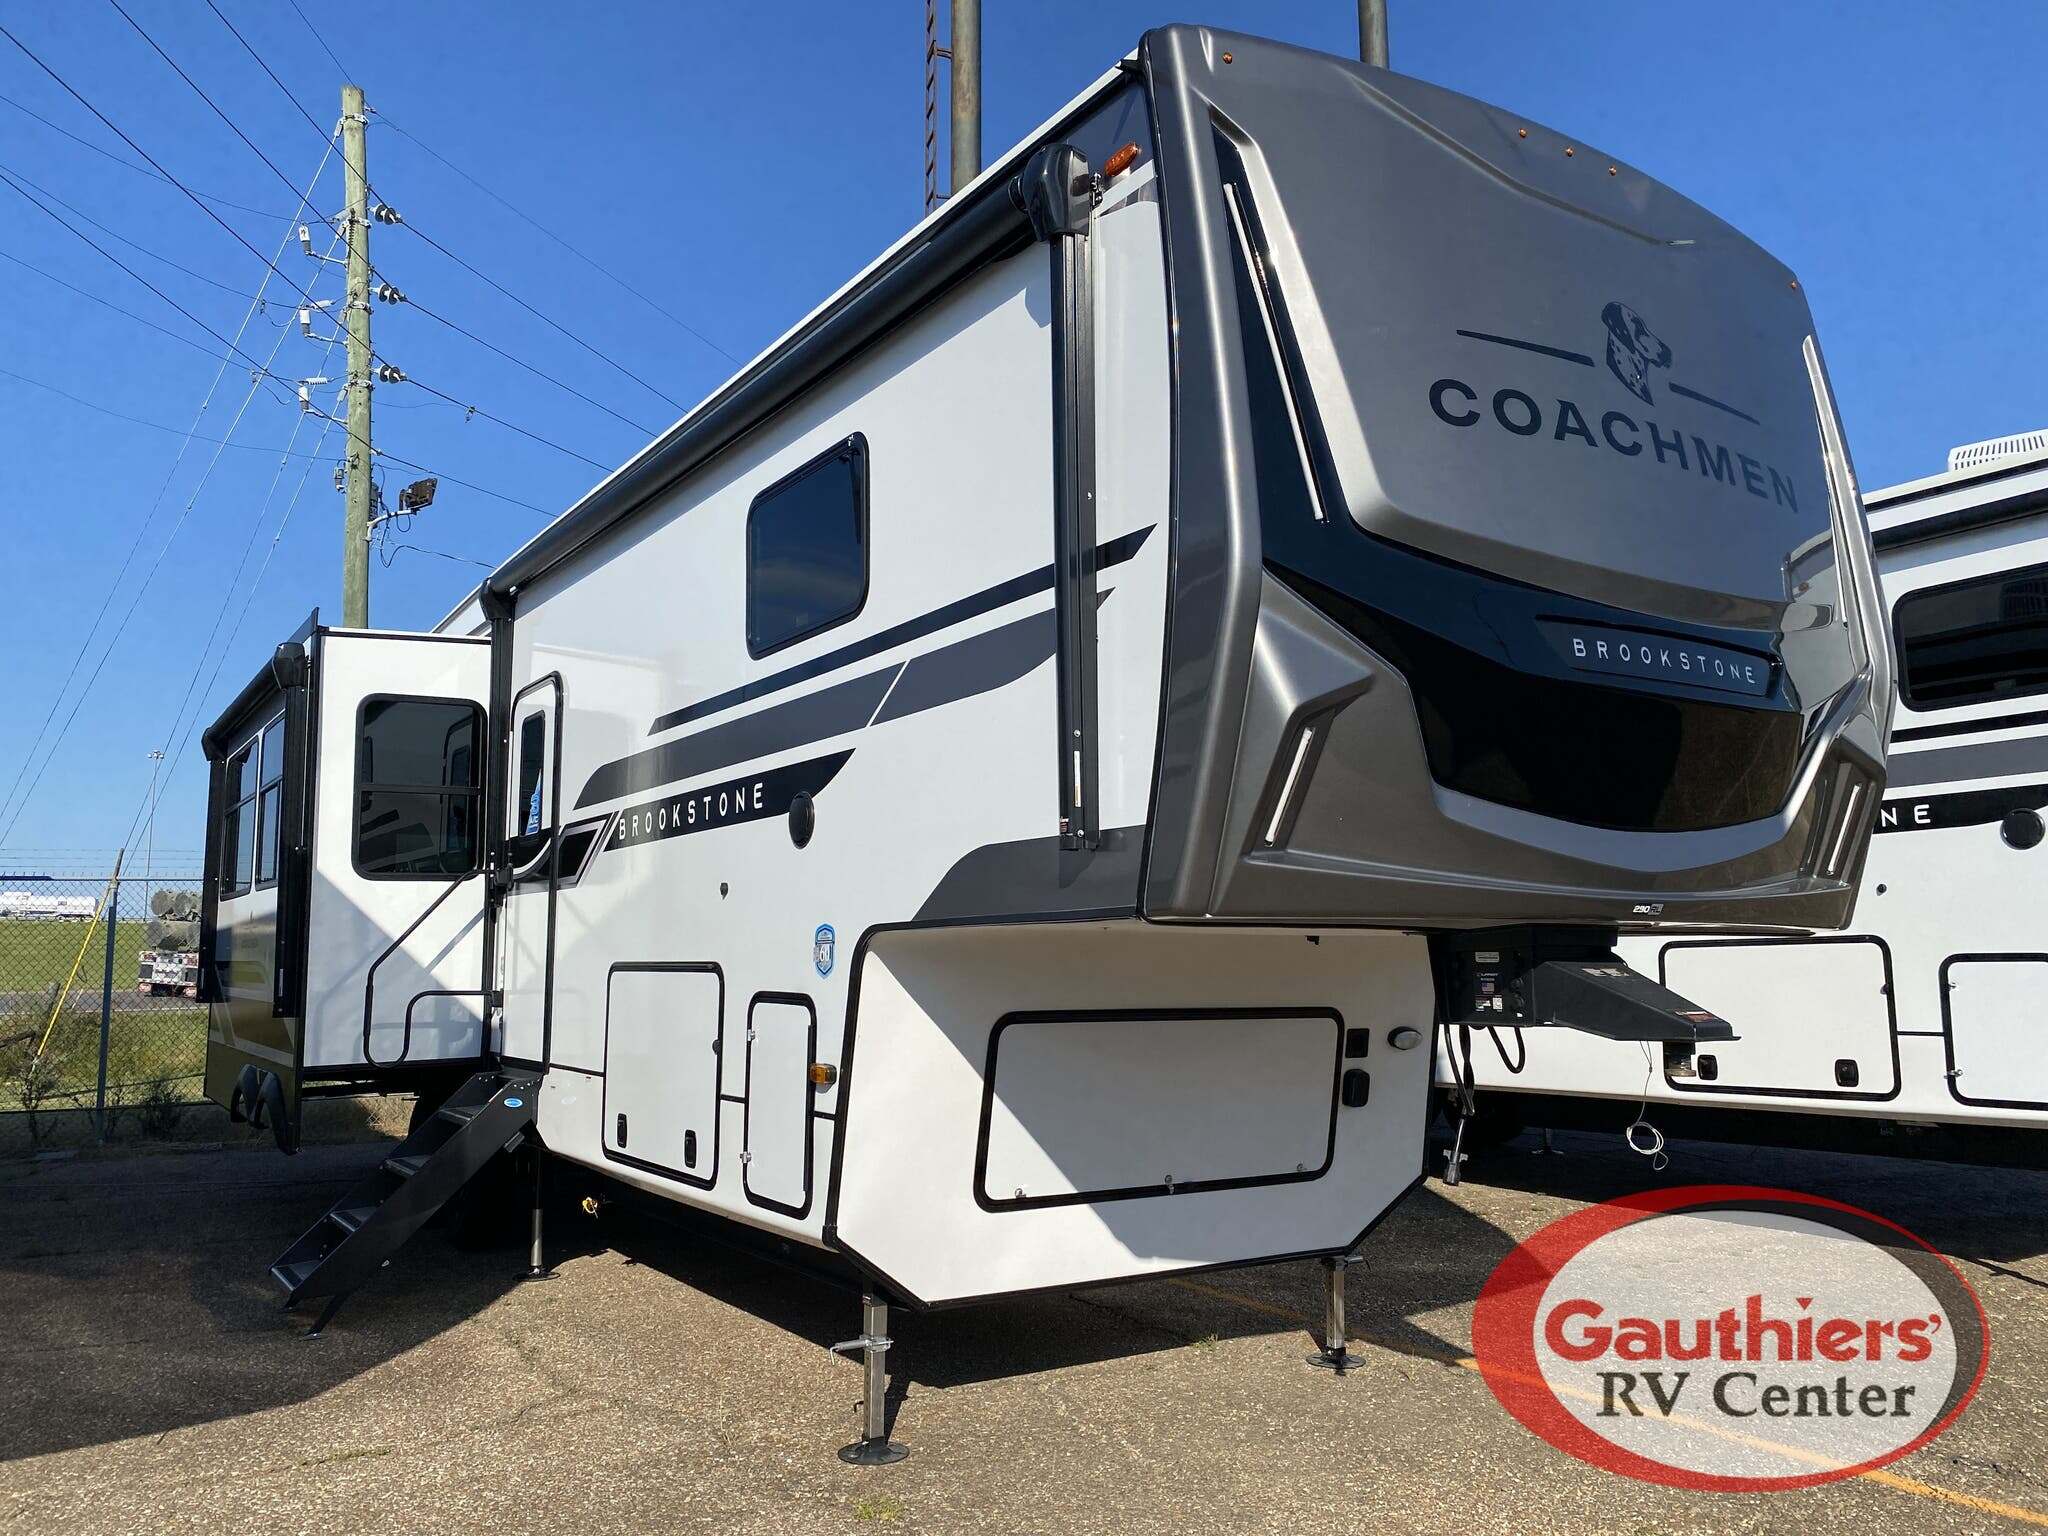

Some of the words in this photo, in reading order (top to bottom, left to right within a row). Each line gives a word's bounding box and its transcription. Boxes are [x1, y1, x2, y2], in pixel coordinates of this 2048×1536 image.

[1428, 378, 1799, 513] COACHMEN
[1572, 638, 1756, 684] BROOKSTONE
[618, 782, 764, 840] BROOKSTONE
